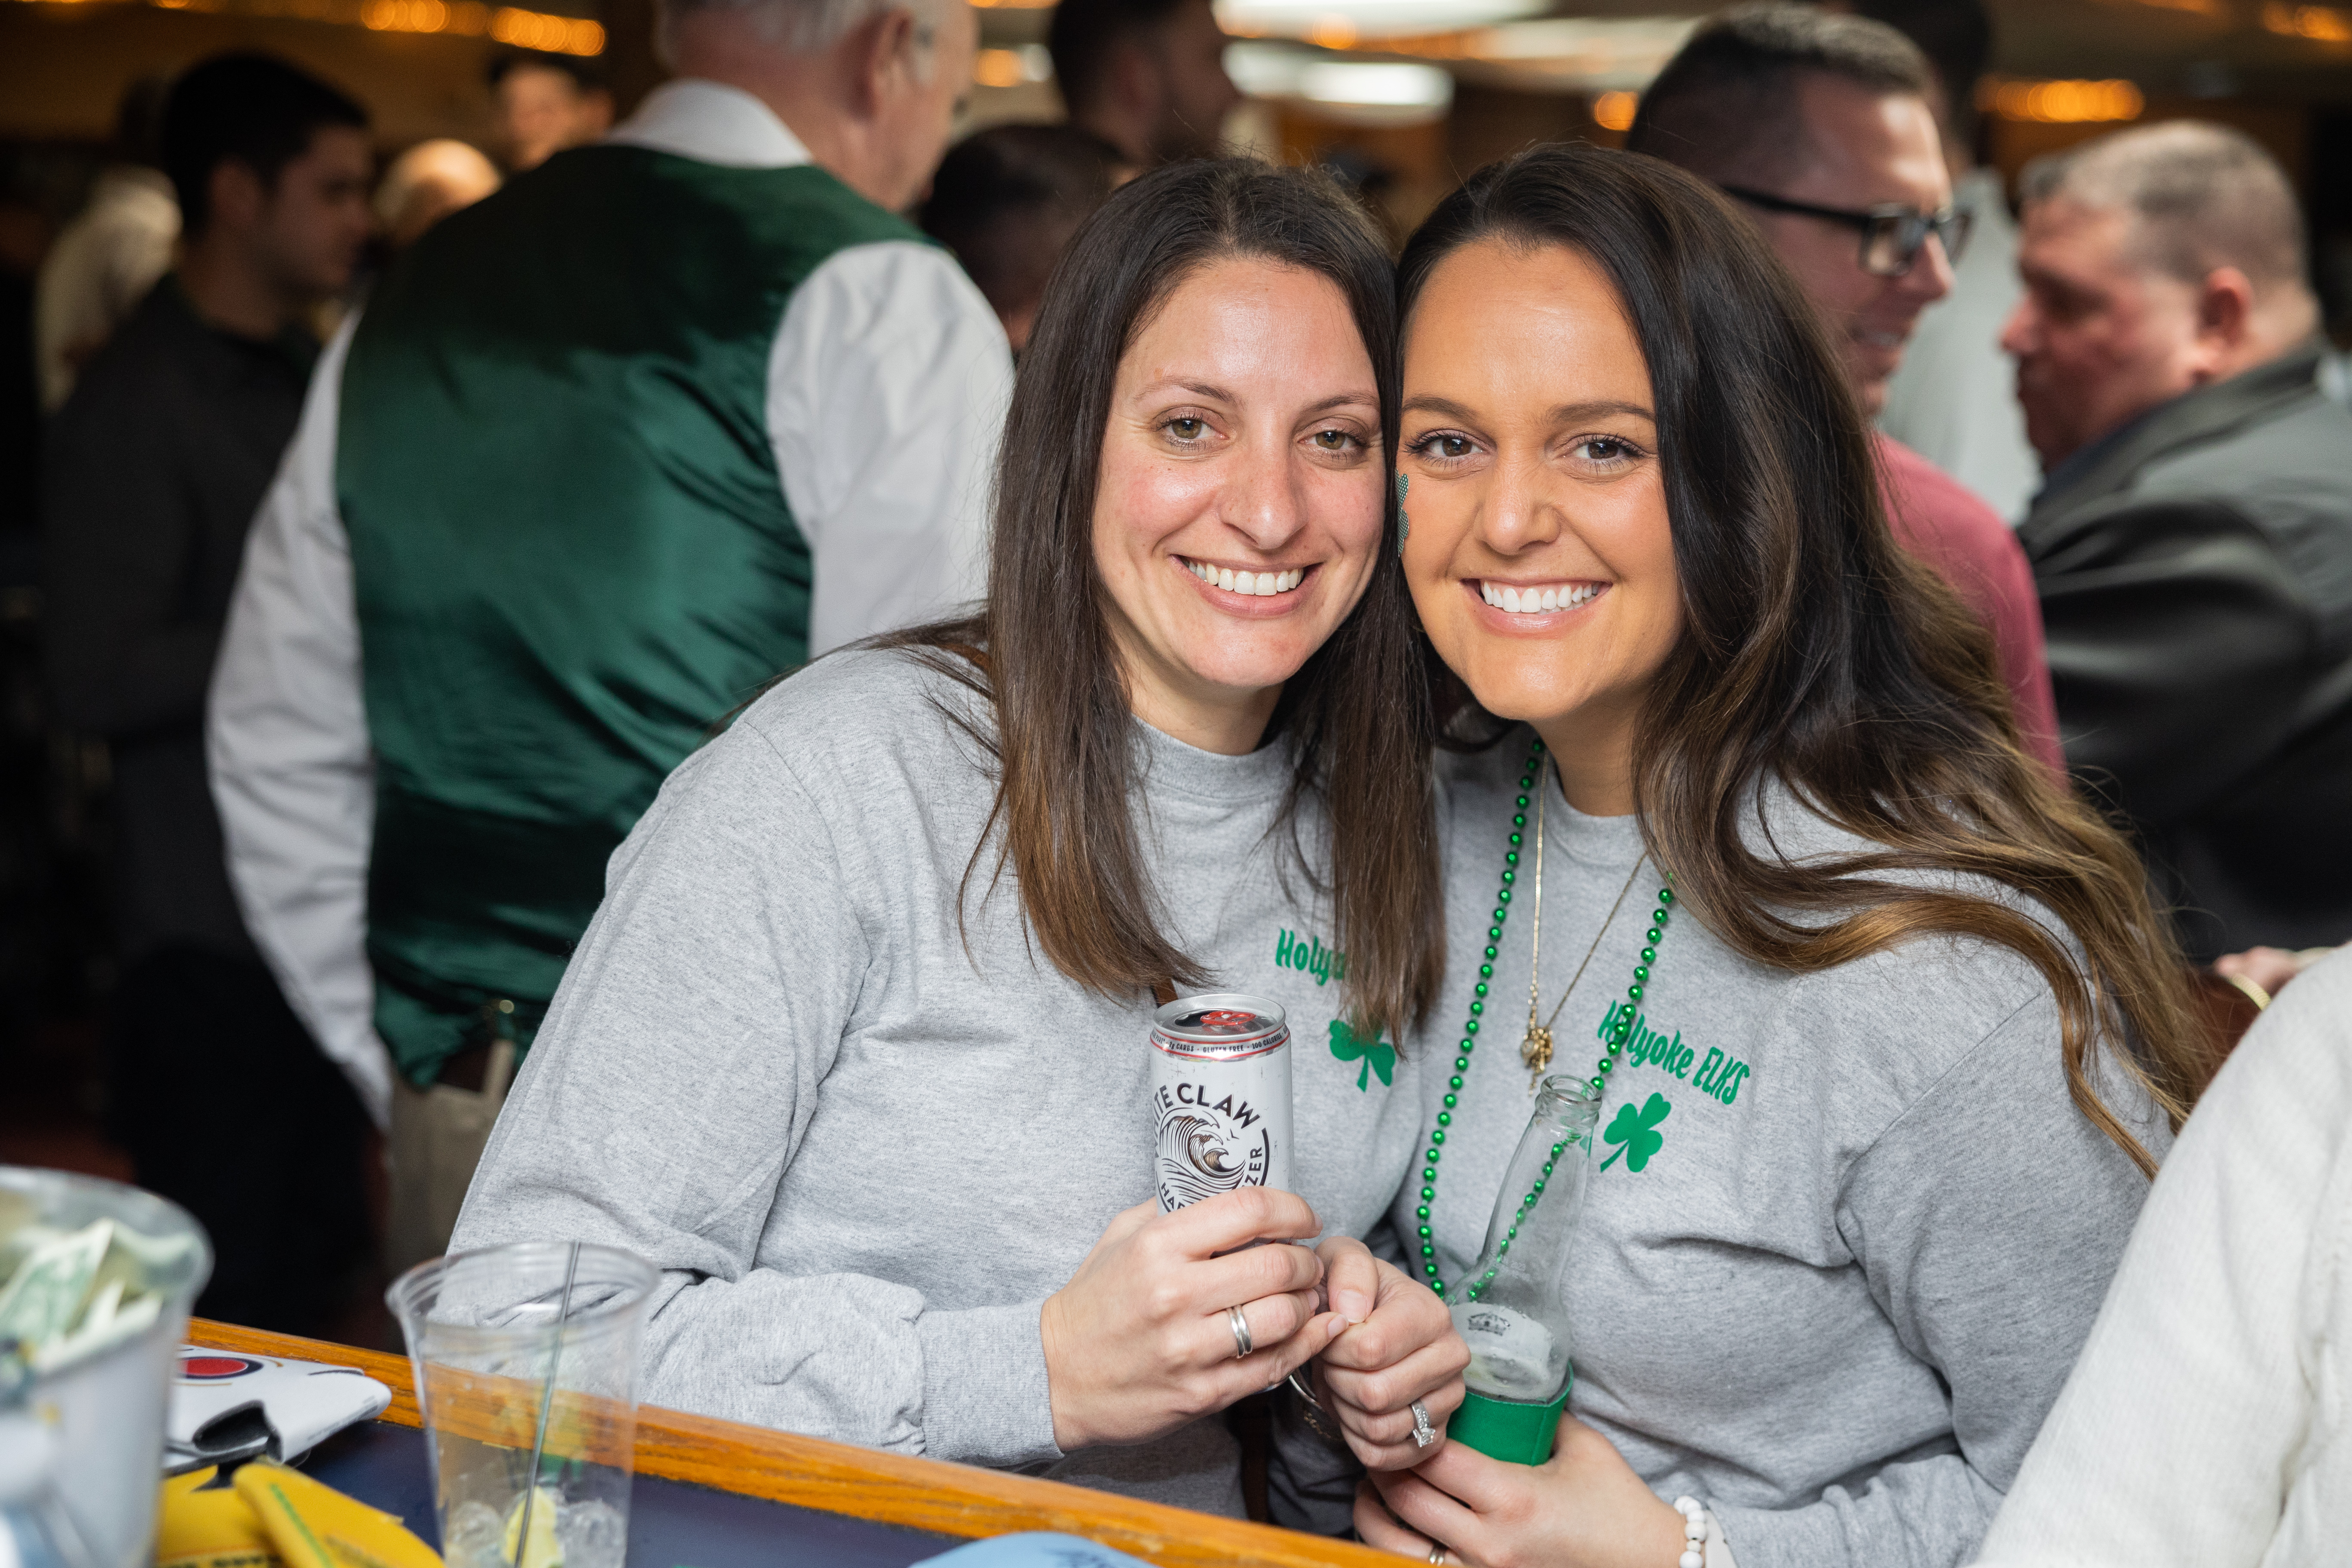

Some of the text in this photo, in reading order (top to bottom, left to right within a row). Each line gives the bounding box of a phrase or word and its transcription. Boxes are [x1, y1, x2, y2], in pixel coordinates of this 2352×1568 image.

[1276, 928, 1345, 986] Holyo
[1169, 1041, 1175, 1050] 2g
[1176, 1043, 1194, 1052] CARBS
[1252, 1041, 1262, 1049] 100
[1263, 1032, 1282, 1046] CALORIES
[1692, 1046, 1750, 1105] ELKS
[1177, 1083, 1260, 1130] CLAW
